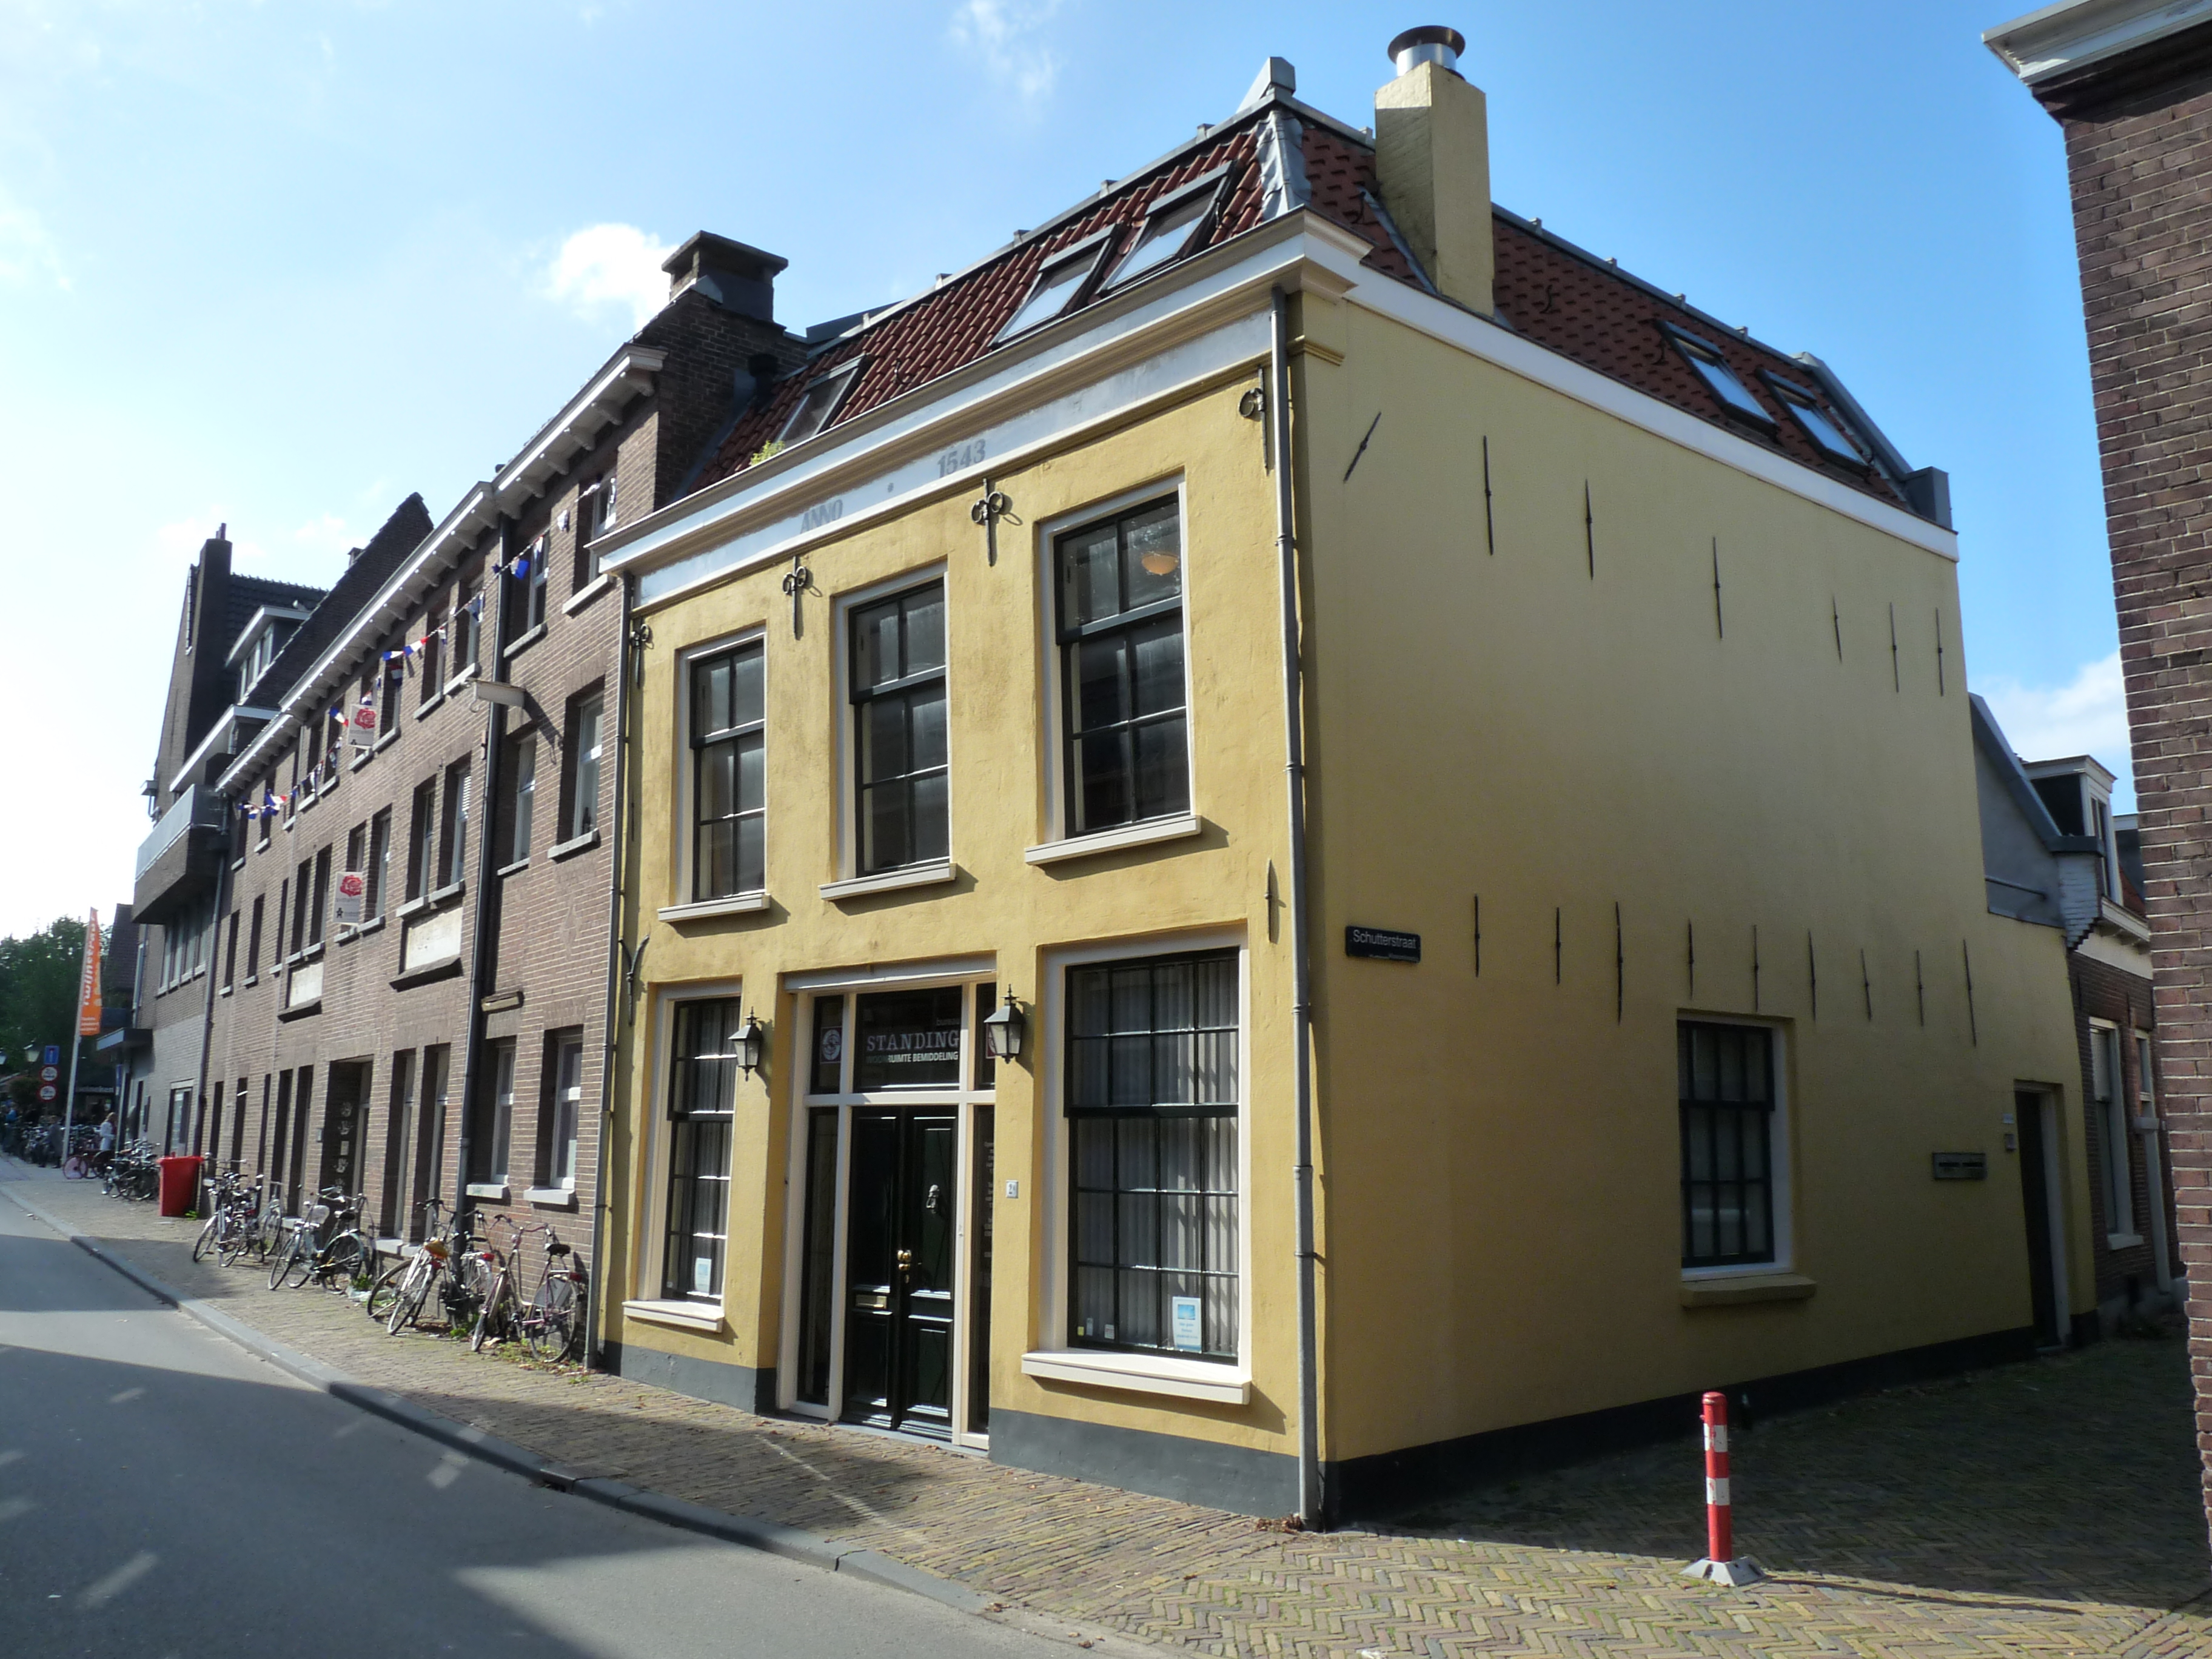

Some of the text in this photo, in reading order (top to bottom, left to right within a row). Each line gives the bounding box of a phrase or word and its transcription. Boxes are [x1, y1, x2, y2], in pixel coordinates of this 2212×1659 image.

[800, 438, 986, 534] ANNO 1543
[1353, 929, 1417, 949] Schutterstraat
[867, 1030, 959, 1051] STANDING
[913, 1051, 958, 1062] BEMIDDELING
